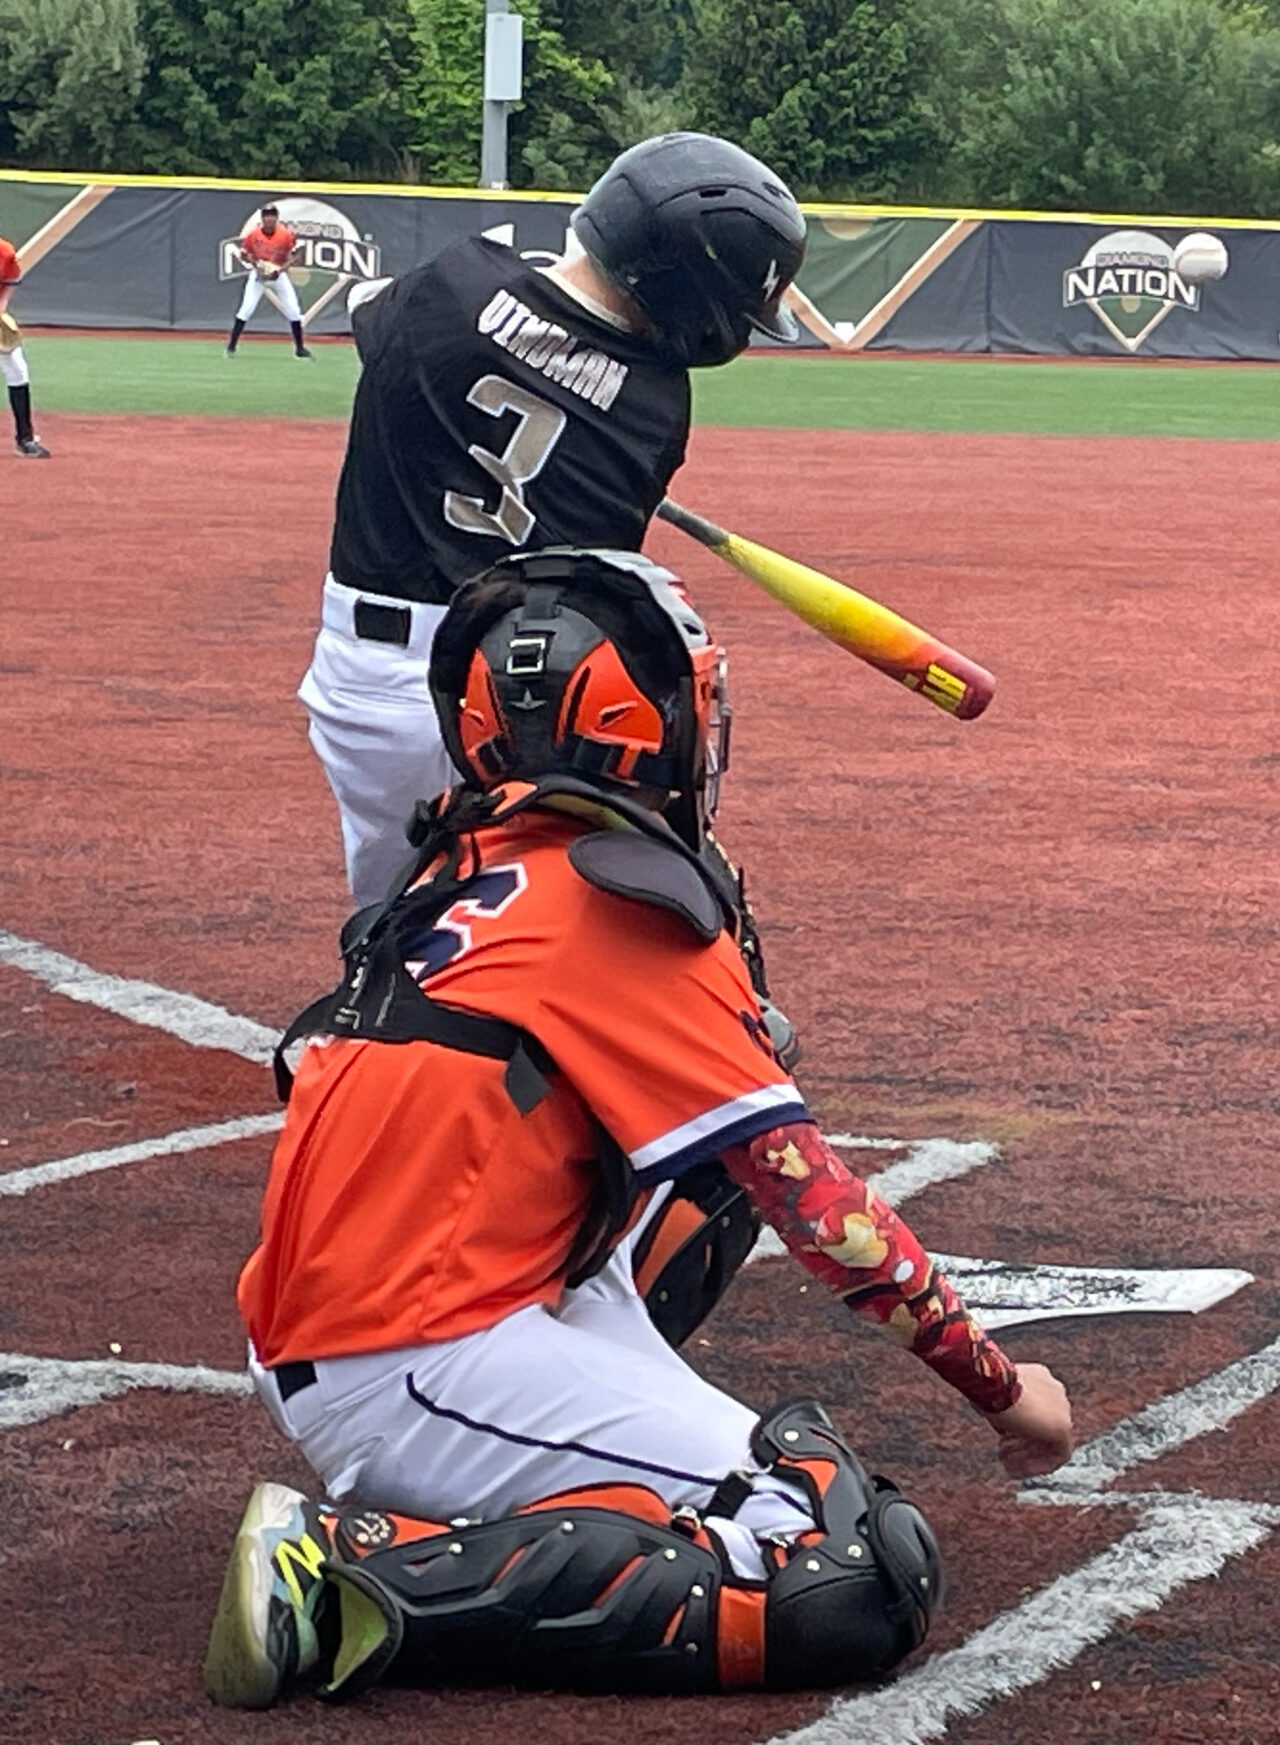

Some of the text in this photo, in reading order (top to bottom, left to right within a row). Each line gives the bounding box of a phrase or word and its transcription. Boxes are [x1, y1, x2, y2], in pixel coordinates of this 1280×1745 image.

[223, 239, 376, 279] NION
[1067, 267, 1197, 306] NATION
[443, 373, 568, 546] 3
